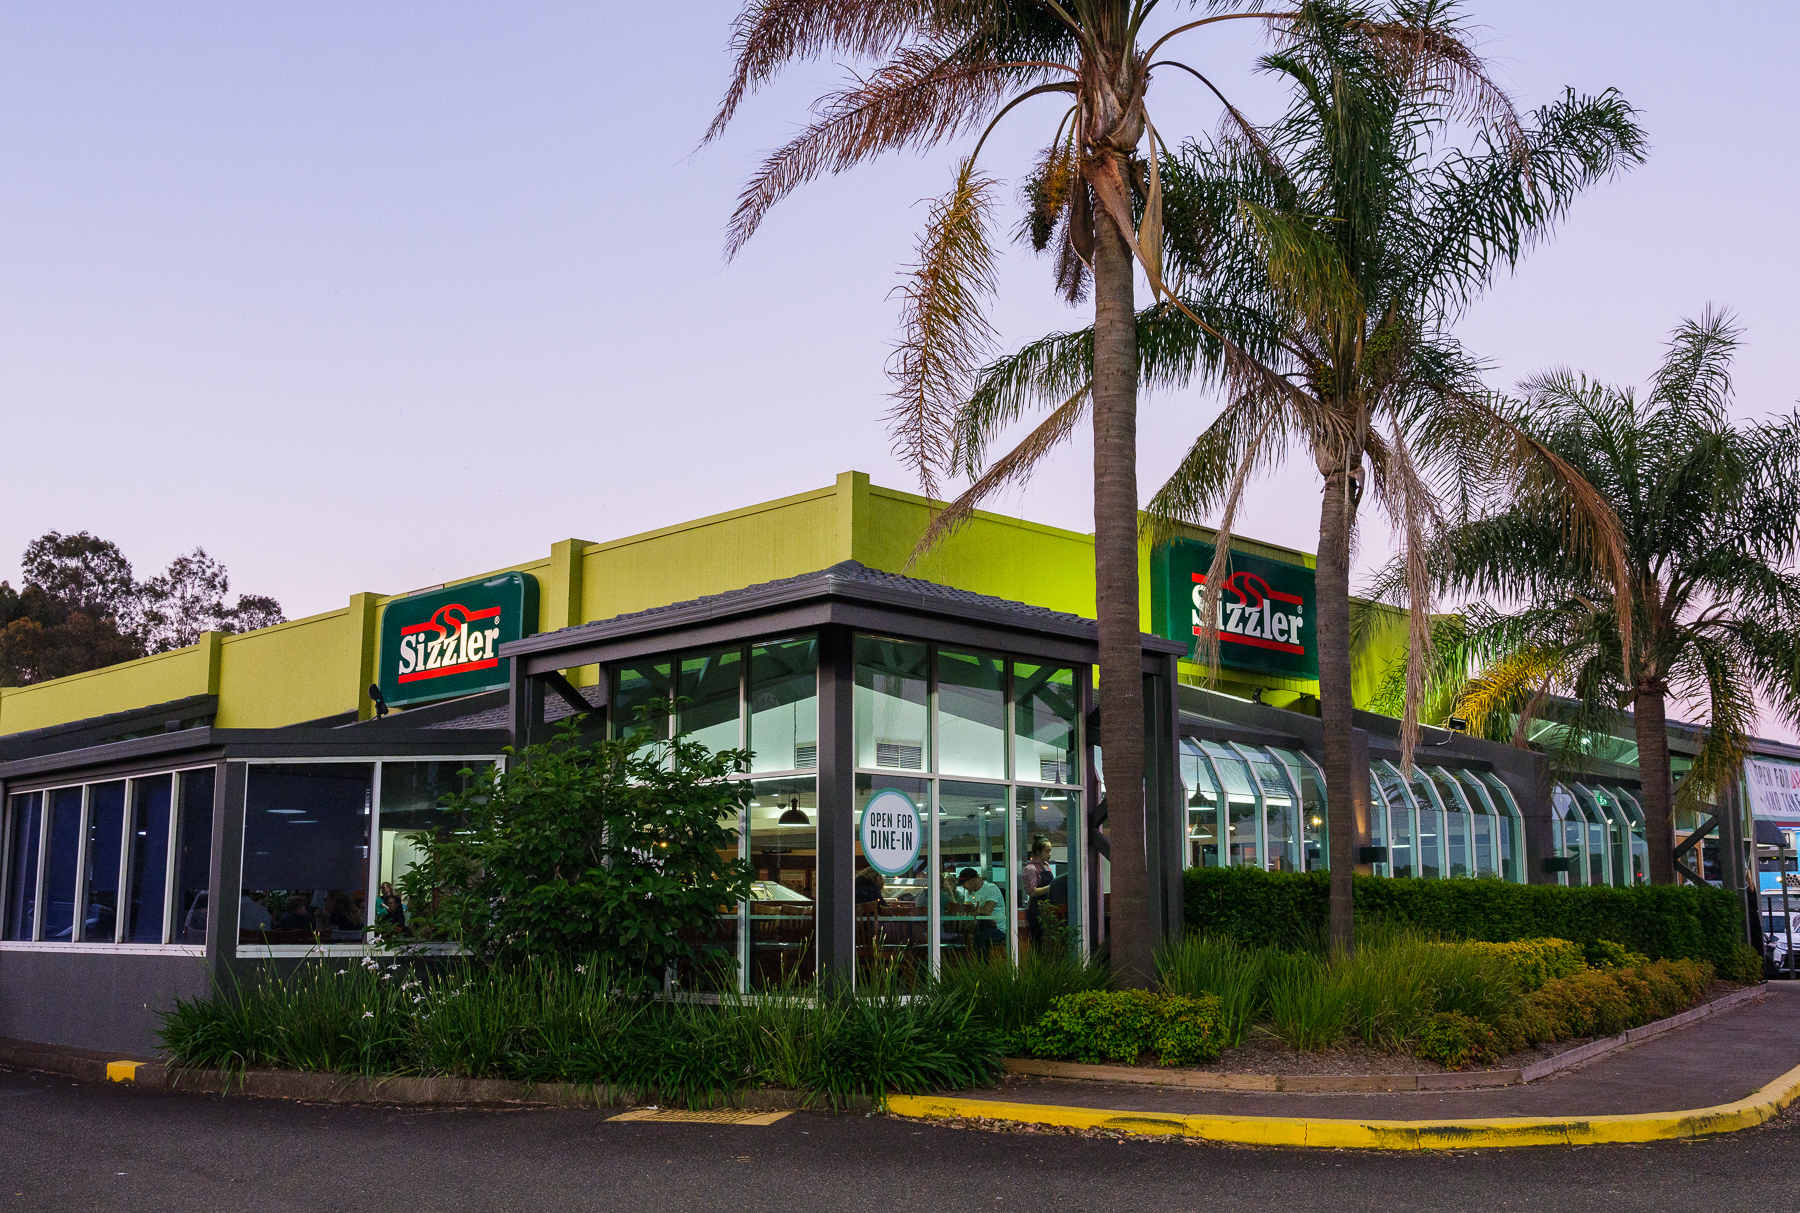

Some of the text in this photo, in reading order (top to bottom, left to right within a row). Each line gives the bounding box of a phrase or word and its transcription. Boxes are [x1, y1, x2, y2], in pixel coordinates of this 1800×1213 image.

[398, 622, 500, 675] Sizzler
[1753, 764, 1774, 787] OPEN
[1773, 767, 1790, 789] FOR
[870, 812, 913, 829] OPEN FOR
[870, 829, 913, 851] DINE-IN
